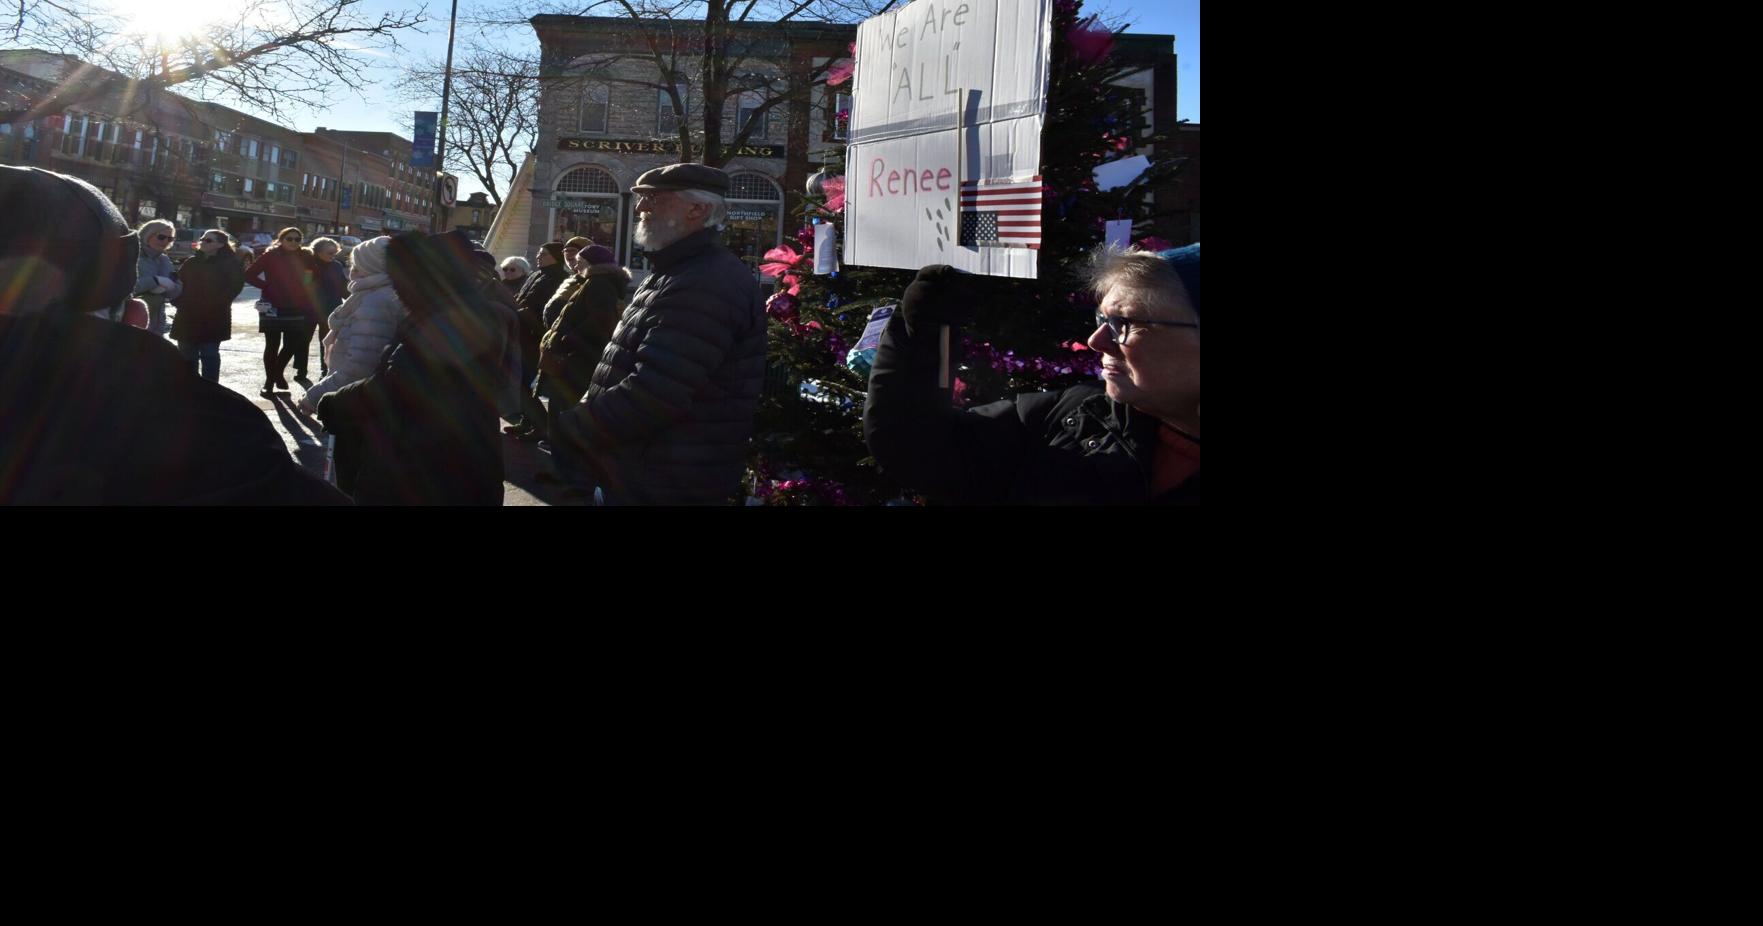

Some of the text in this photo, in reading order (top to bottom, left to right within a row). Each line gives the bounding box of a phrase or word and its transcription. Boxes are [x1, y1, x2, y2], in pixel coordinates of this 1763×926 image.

[880, 3, 969, 51] We Are
[568, 140, 664, 152] SCRIVER
[868, 157, 952, 198] Renee
